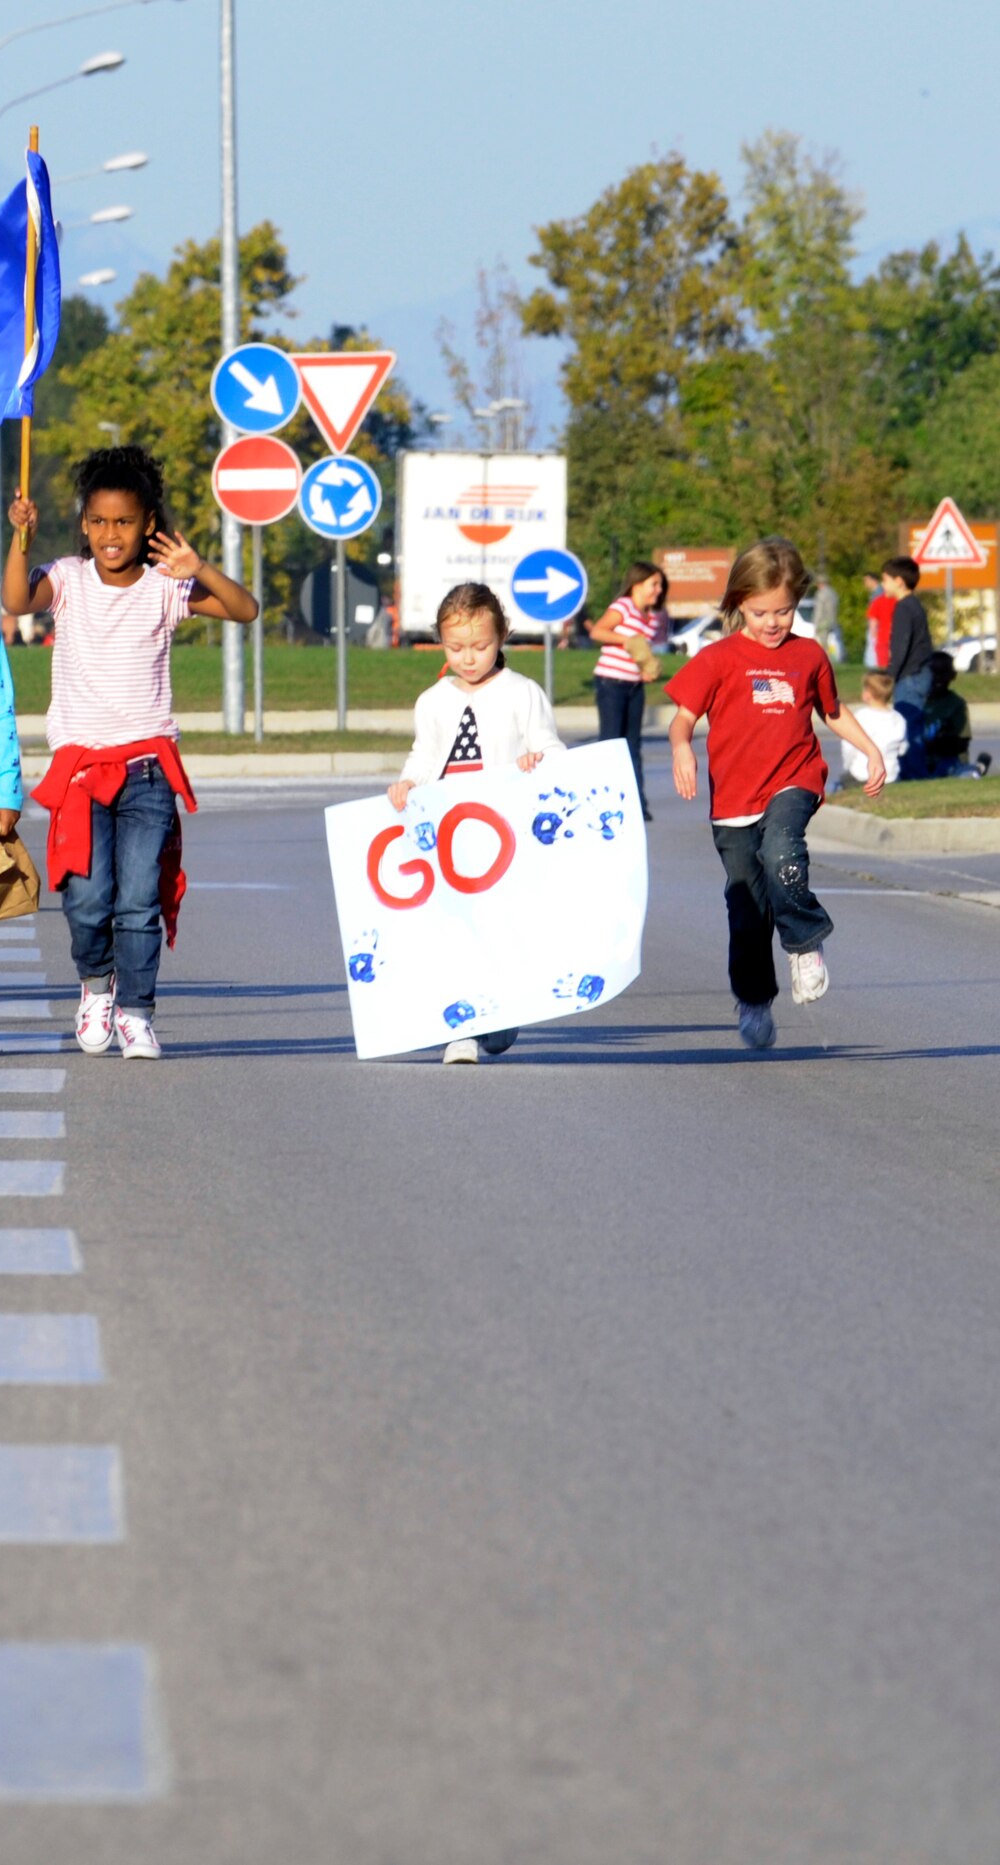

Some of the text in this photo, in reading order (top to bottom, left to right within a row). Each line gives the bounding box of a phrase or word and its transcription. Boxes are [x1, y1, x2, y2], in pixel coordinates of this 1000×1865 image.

[423, 507, 459, 519] JAN
[470, 508, 493, 520] DE
[367, 802, 516, 910] GO
